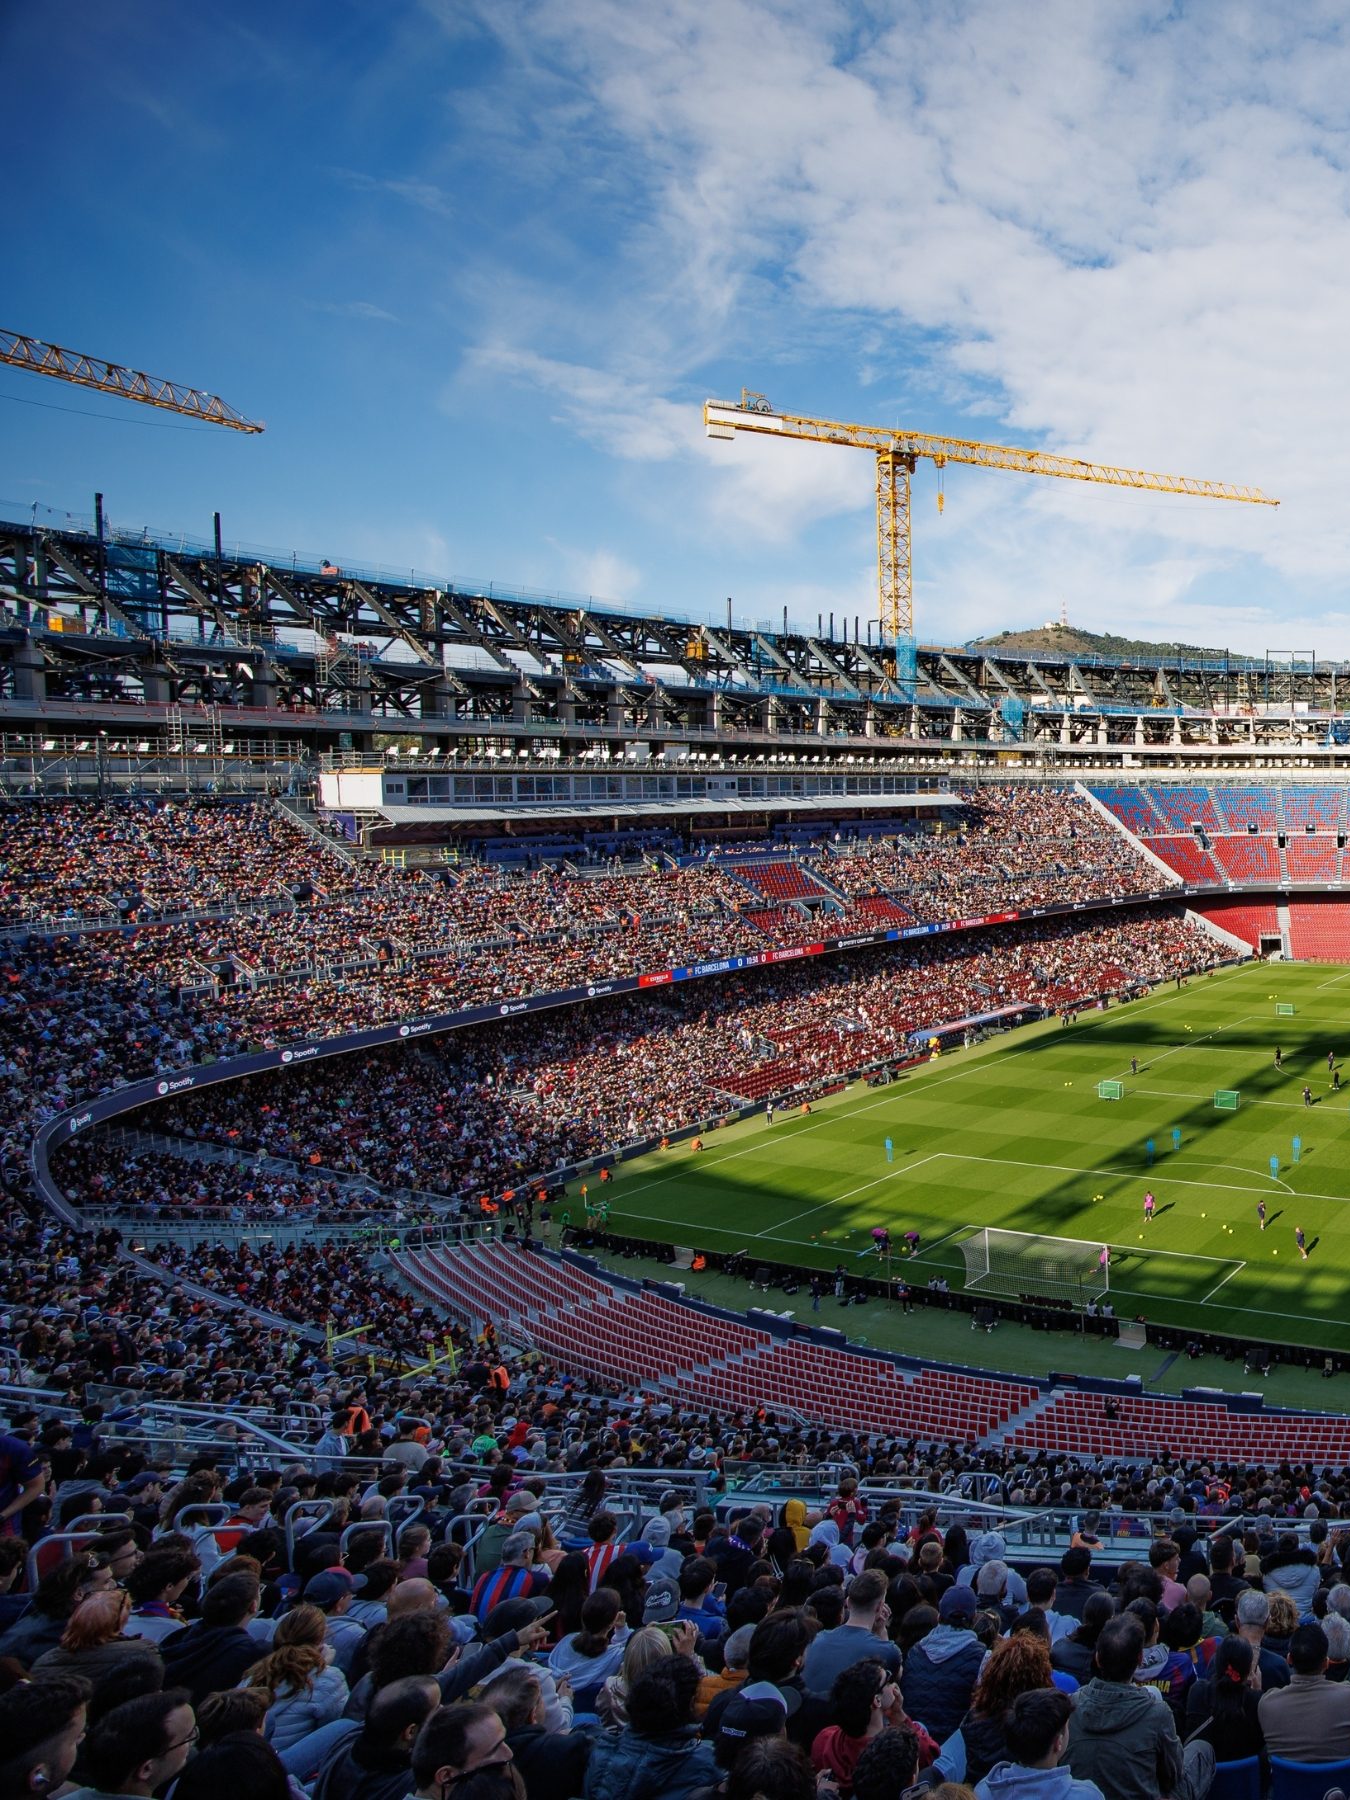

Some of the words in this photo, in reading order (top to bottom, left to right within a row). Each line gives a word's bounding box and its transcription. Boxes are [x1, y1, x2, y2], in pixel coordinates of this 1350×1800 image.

[410, 1022, 433, 1033] Spotify
[293, 1047, 320, 1058] Spotify
[169, 1077, 195, 1090] Spotify
